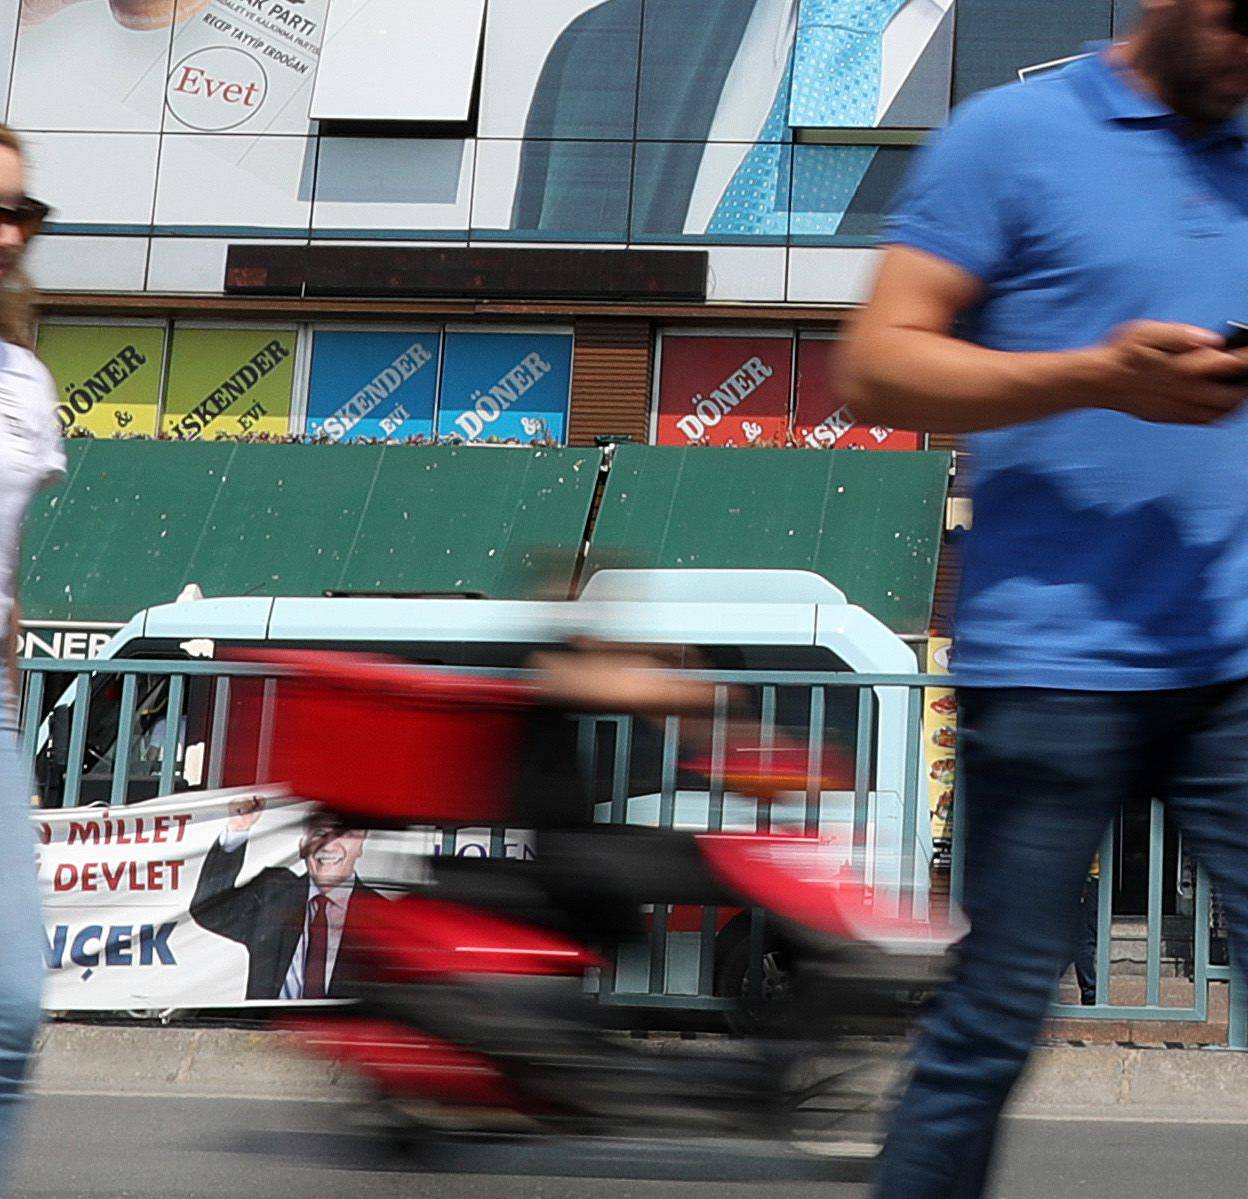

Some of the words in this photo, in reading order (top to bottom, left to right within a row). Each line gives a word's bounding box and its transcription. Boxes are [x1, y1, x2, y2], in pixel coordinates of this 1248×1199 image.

[203, 13, 232, 32] RECEP
[268, 4, 317, 36] PARTİ
[173, 66, 259, 106] Evet
[56, 345, 146, 429] DÖNER
[455, 352, 551, 440] DÖNER
[676, 356, 773, 440] DÖNER
[114, 410, 133, 427] &
[741, 421, 762, 441] &
[67, 810, 192, 845] MİLLET
[54, 860, 185, 891] DEVLET
